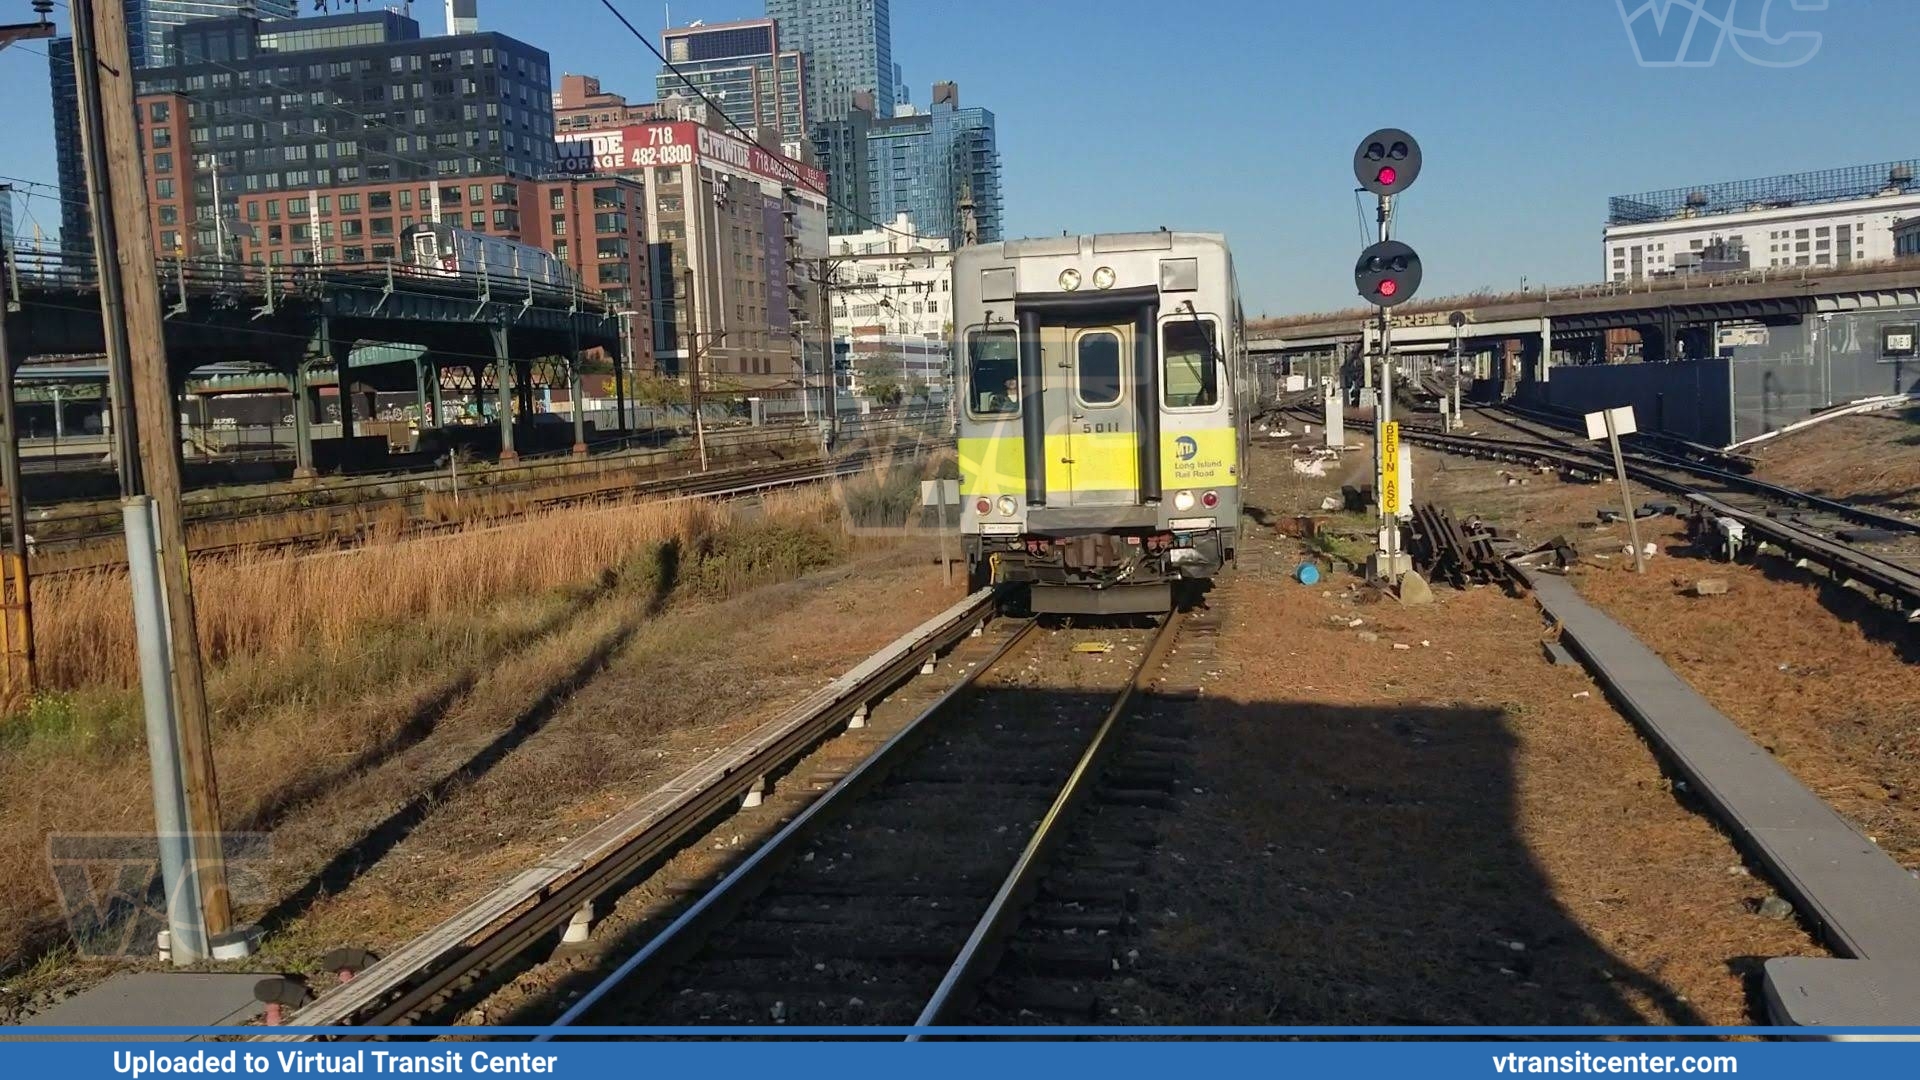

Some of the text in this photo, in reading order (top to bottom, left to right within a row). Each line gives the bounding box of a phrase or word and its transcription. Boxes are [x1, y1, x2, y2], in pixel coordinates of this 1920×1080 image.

[648, 127, 673, 145] 718
[554, 133, 624, 158] WIDE
[556, 155, 625, 170] TORAGE
[632, 144, 692, 166] 482-0300
[1083, 422, 1119, 434] 5011
[1174, 460, 1223, 470] Long Island
[1386, 425, 1396, 509] BEGIN ASC
[1192, 470, 1215, 478] Road
